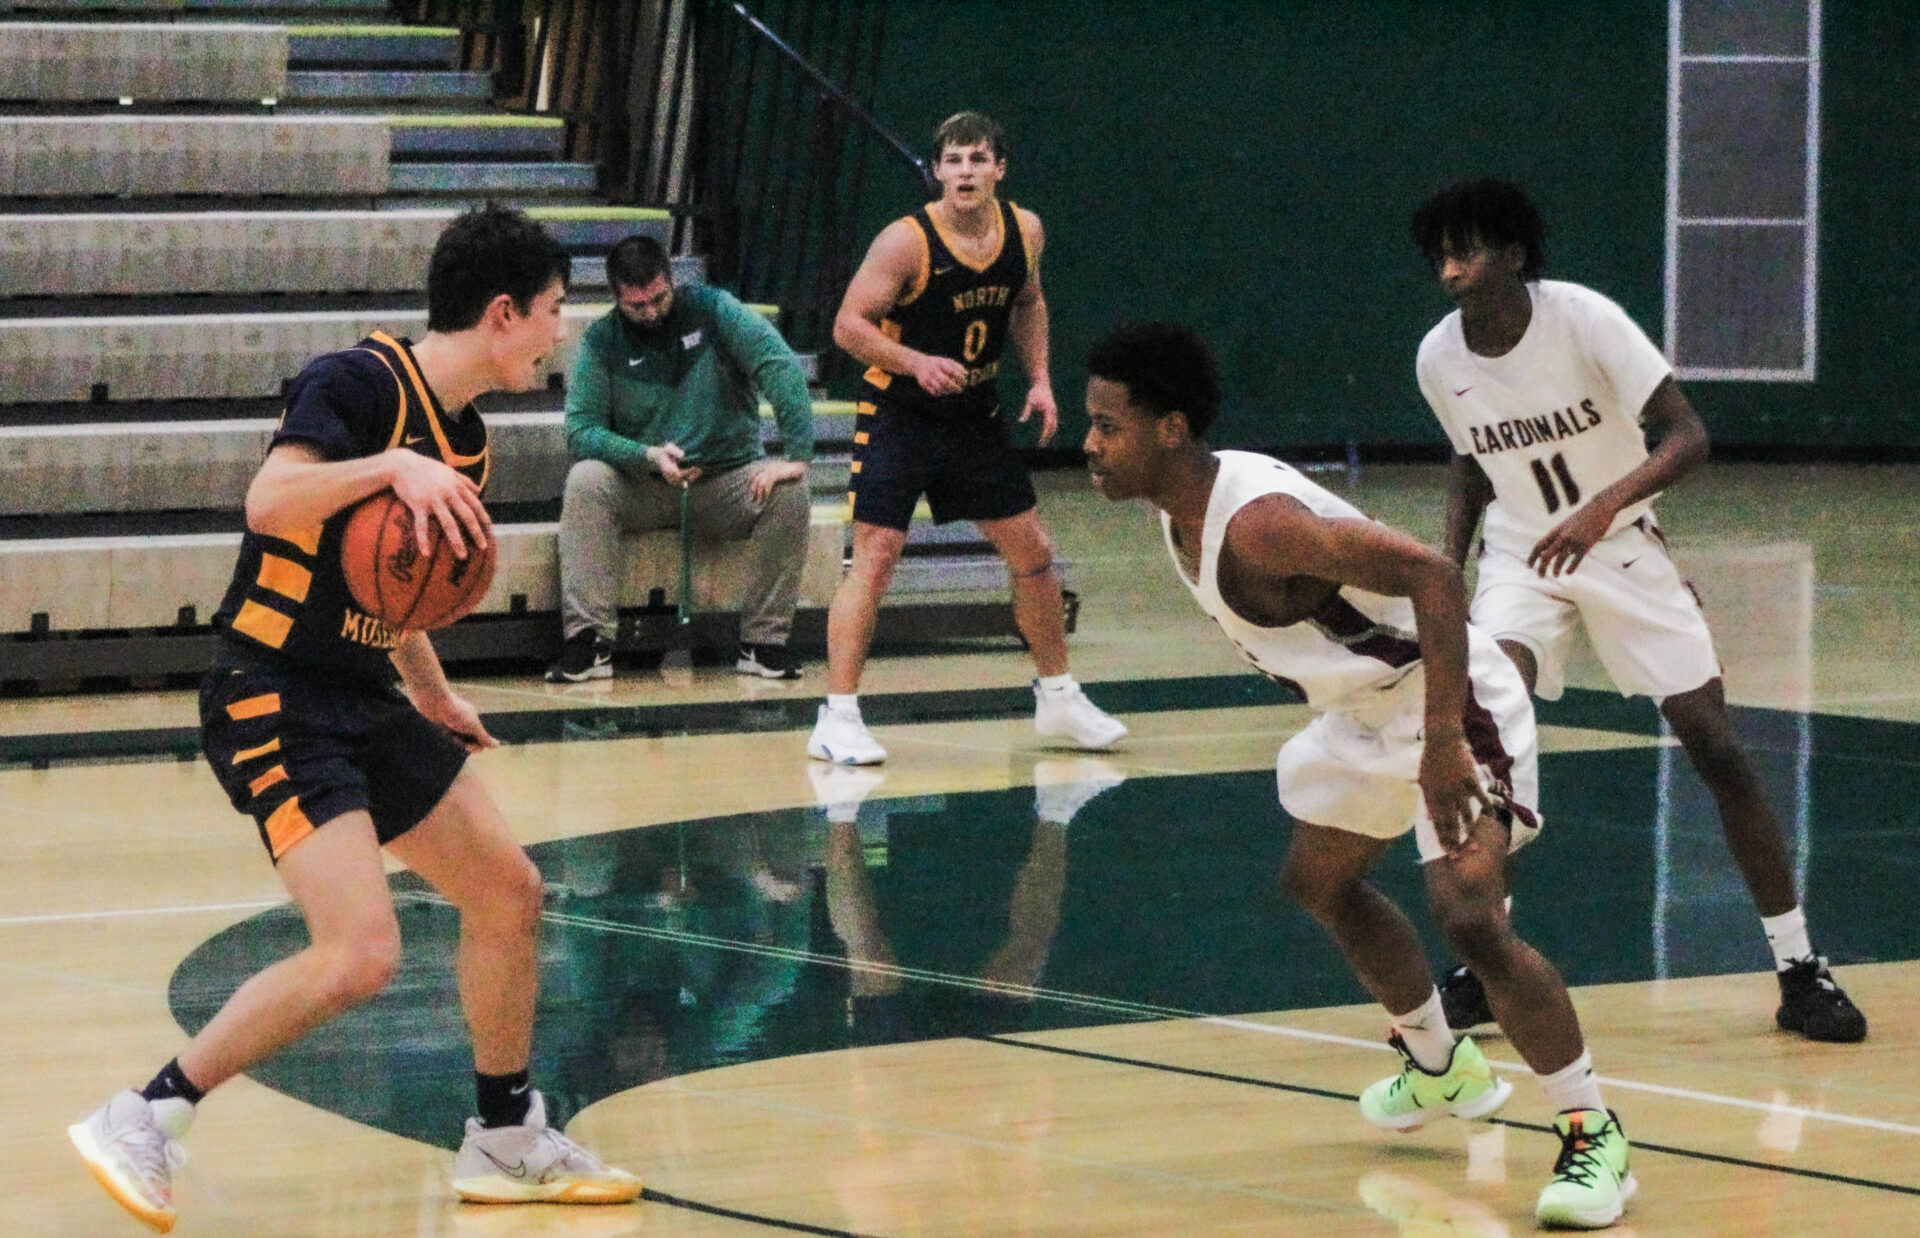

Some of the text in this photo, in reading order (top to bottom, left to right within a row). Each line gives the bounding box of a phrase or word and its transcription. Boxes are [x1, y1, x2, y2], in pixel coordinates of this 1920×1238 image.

[953, 286, 1010, 313] NORTH
[963, 320, 988, 361] 0
[1469, 398, 1602, 454] CARDINALS
[1530, 454, 1580, 514] 11
